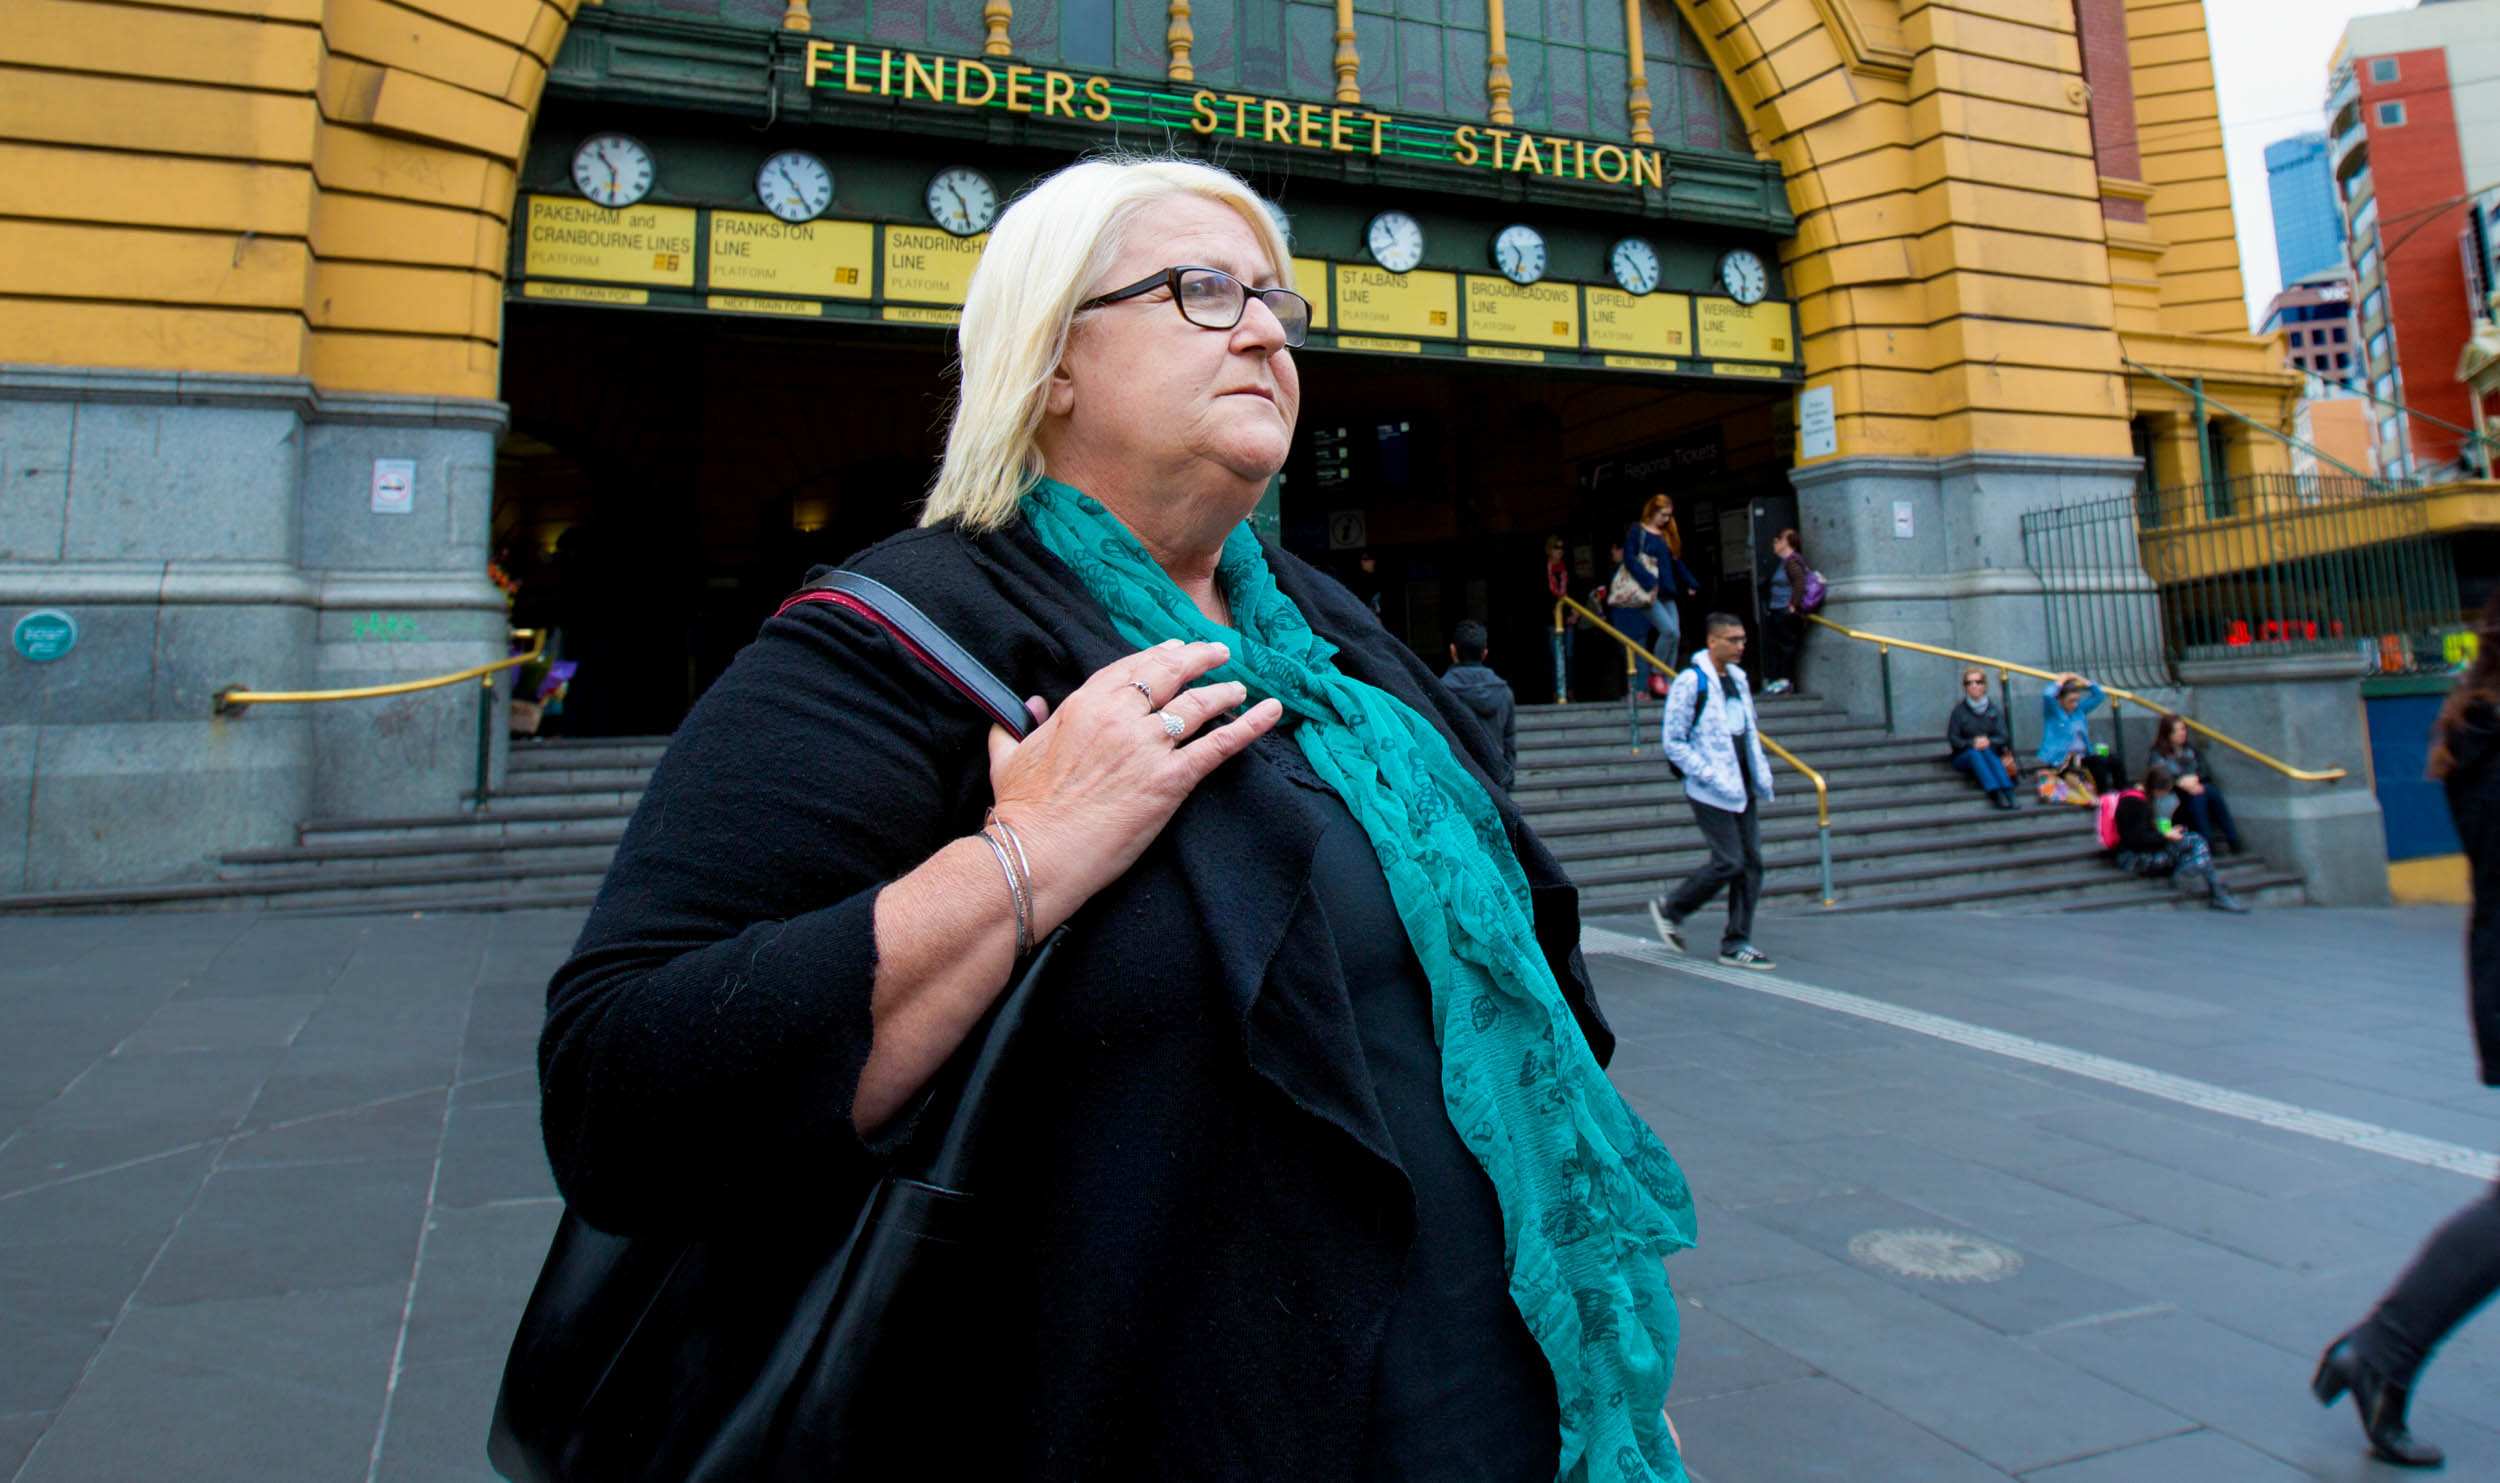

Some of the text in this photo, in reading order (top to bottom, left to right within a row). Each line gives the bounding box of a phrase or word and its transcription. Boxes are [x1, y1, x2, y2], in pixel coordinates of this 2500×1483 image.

[806, 40, 1662, 189] FLINDERS STREET STATION
[533, 203, 656, 229] PAKENHAM and
[715, 218, 815, 241] FRANKSTON
[532, 226, 690, 254] CRANBOURNE LINES
[893, 233, 988, 255] SANDRINGH
[714, 240, 751, 257] LINE
[531, 253, 600, 266] PLATFORM
[892, 255, 925, 271] LINE
[713, 266, 777, 280] PLATFORM
[1343, 270, 1409, 289] ST ALBANS
[892, 278, 950, 291] PLATFORM
[1472, 281, 1569, 303] BROADMEADOWS
[723, 297, 750, 309] NEXT
[753, 299, 782, 311] TRAIN
[1342, 290, 1370, 304] LINE
[1592, 293, 1636, 309] UPFIELD
[898, 309, 924, 319] NEXT
[1472, 301, 1497, 315] LINE
[1703, 303, 1755, 319] WERRIBEE
[1593, 310, 1617, 324] LINE
[1704, 320, 1726, 333] LINE
